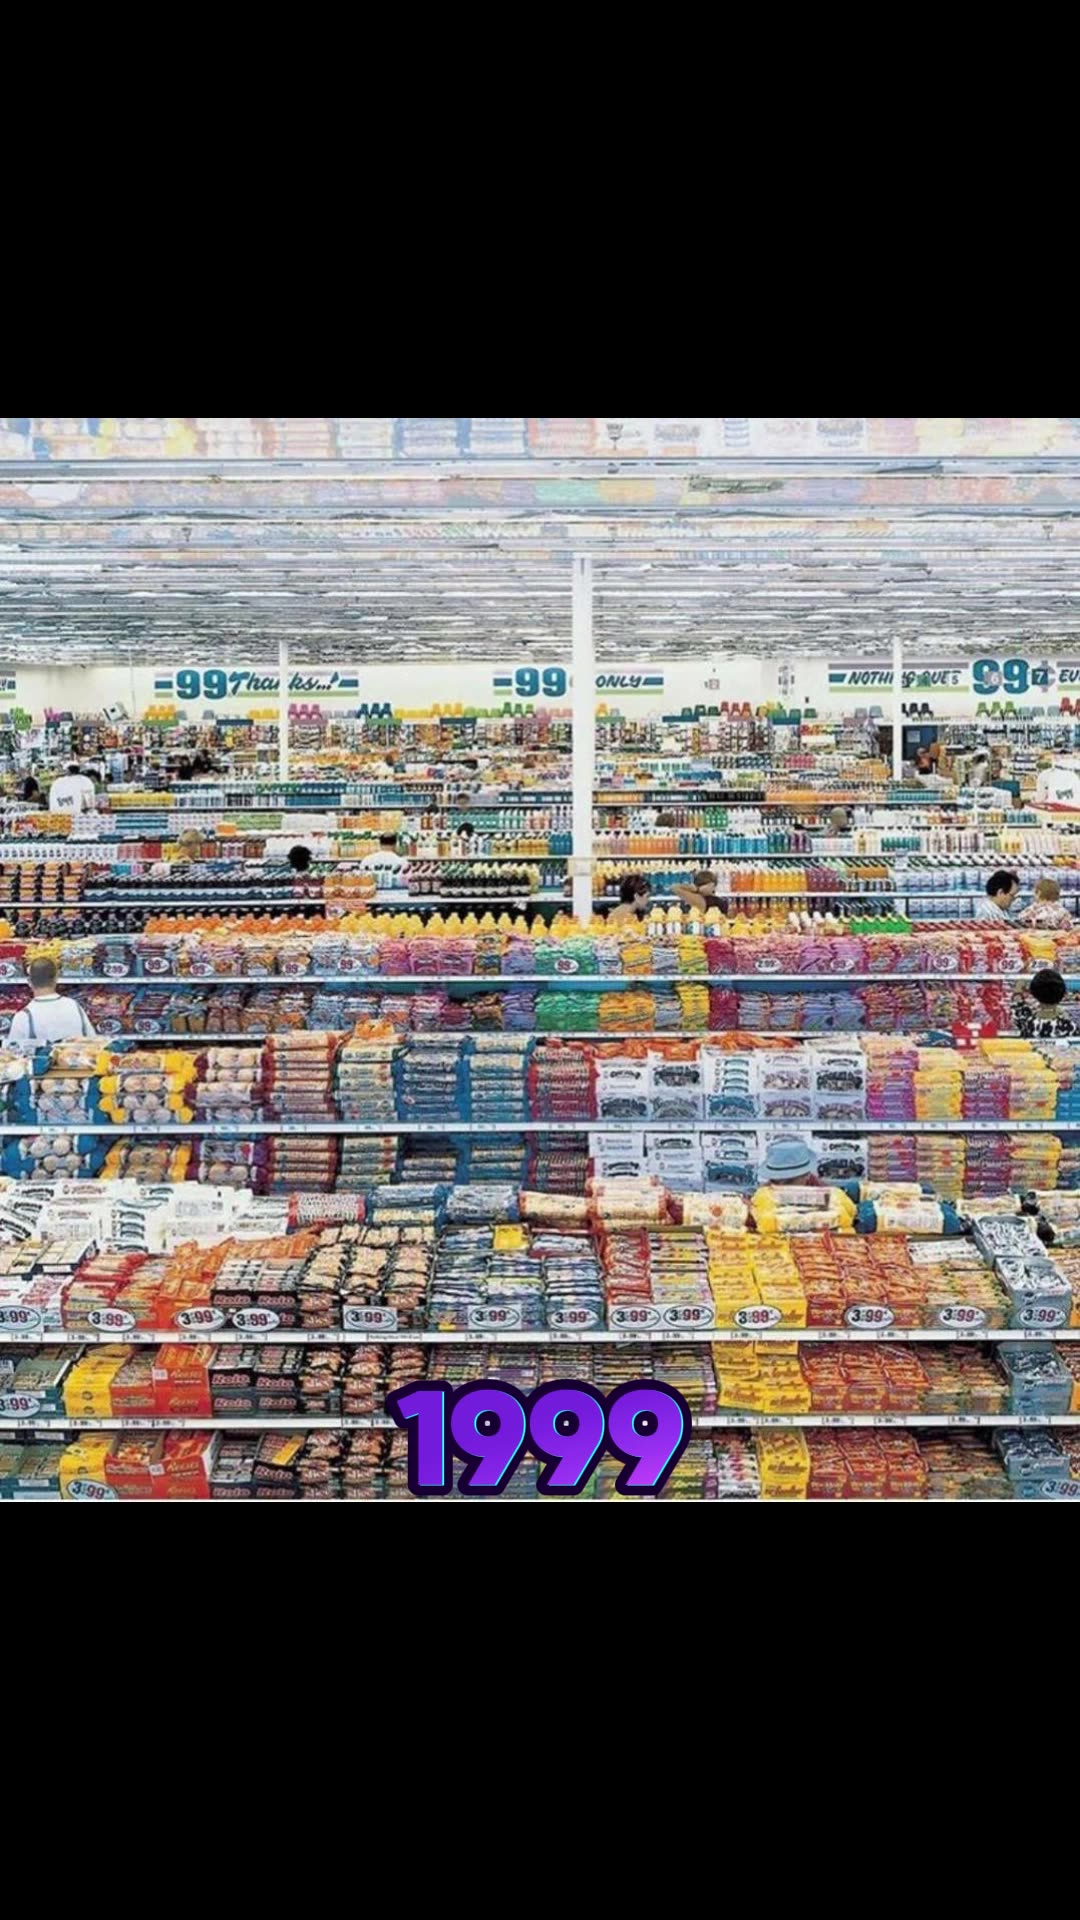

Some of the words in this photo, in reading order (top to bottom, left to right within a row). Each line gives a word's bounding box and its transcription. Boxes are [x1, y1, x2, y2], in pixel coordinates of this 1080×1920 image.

[176, 669, 228, 700] 99
[515, 667, 567, 697] 99
[595, 675, 642, 688] ONLY
[848, 670, 915, 686] NOTHIG
